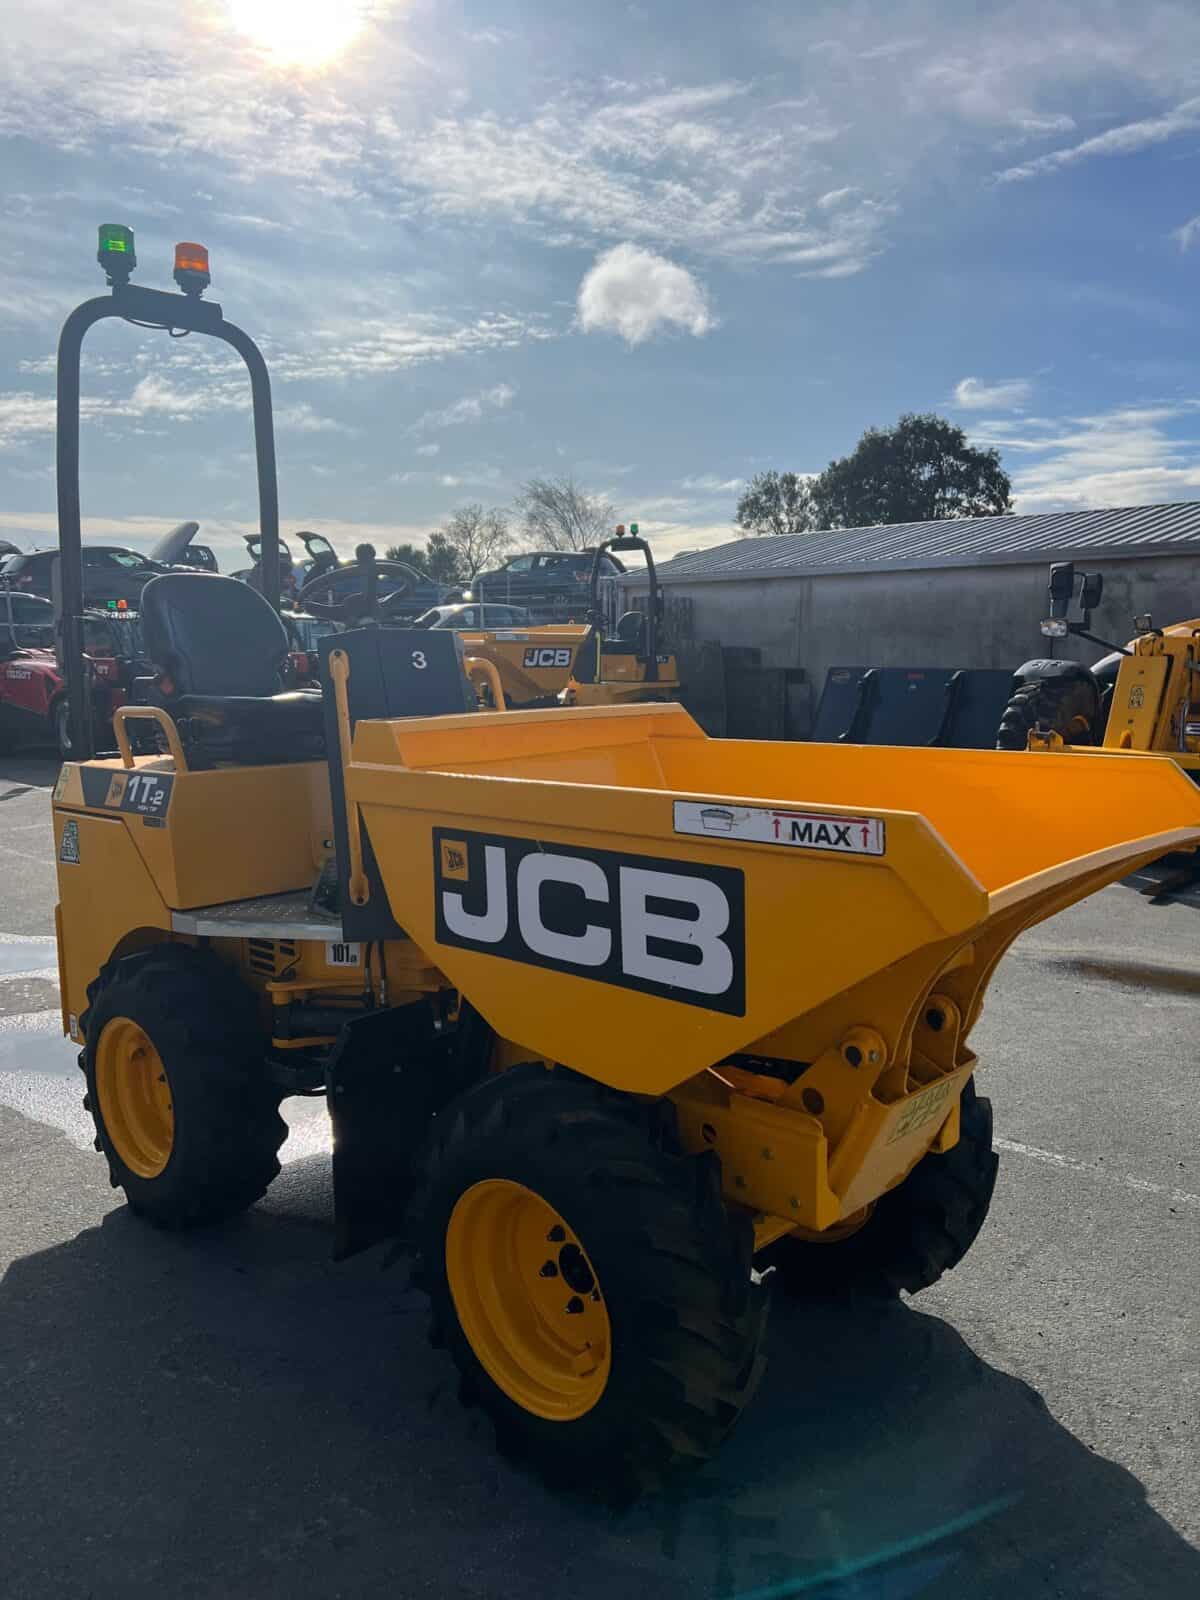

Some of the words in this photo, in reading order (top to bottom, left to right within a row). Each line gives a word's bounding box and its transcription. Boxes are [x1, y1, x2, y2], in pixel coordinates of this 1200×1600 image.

[412, 651, 427, 669] 3
[525, 648, 570, 667] JCB
[791, 820, 852, 847] MAX
[443, 845, 734, 995] JCB
